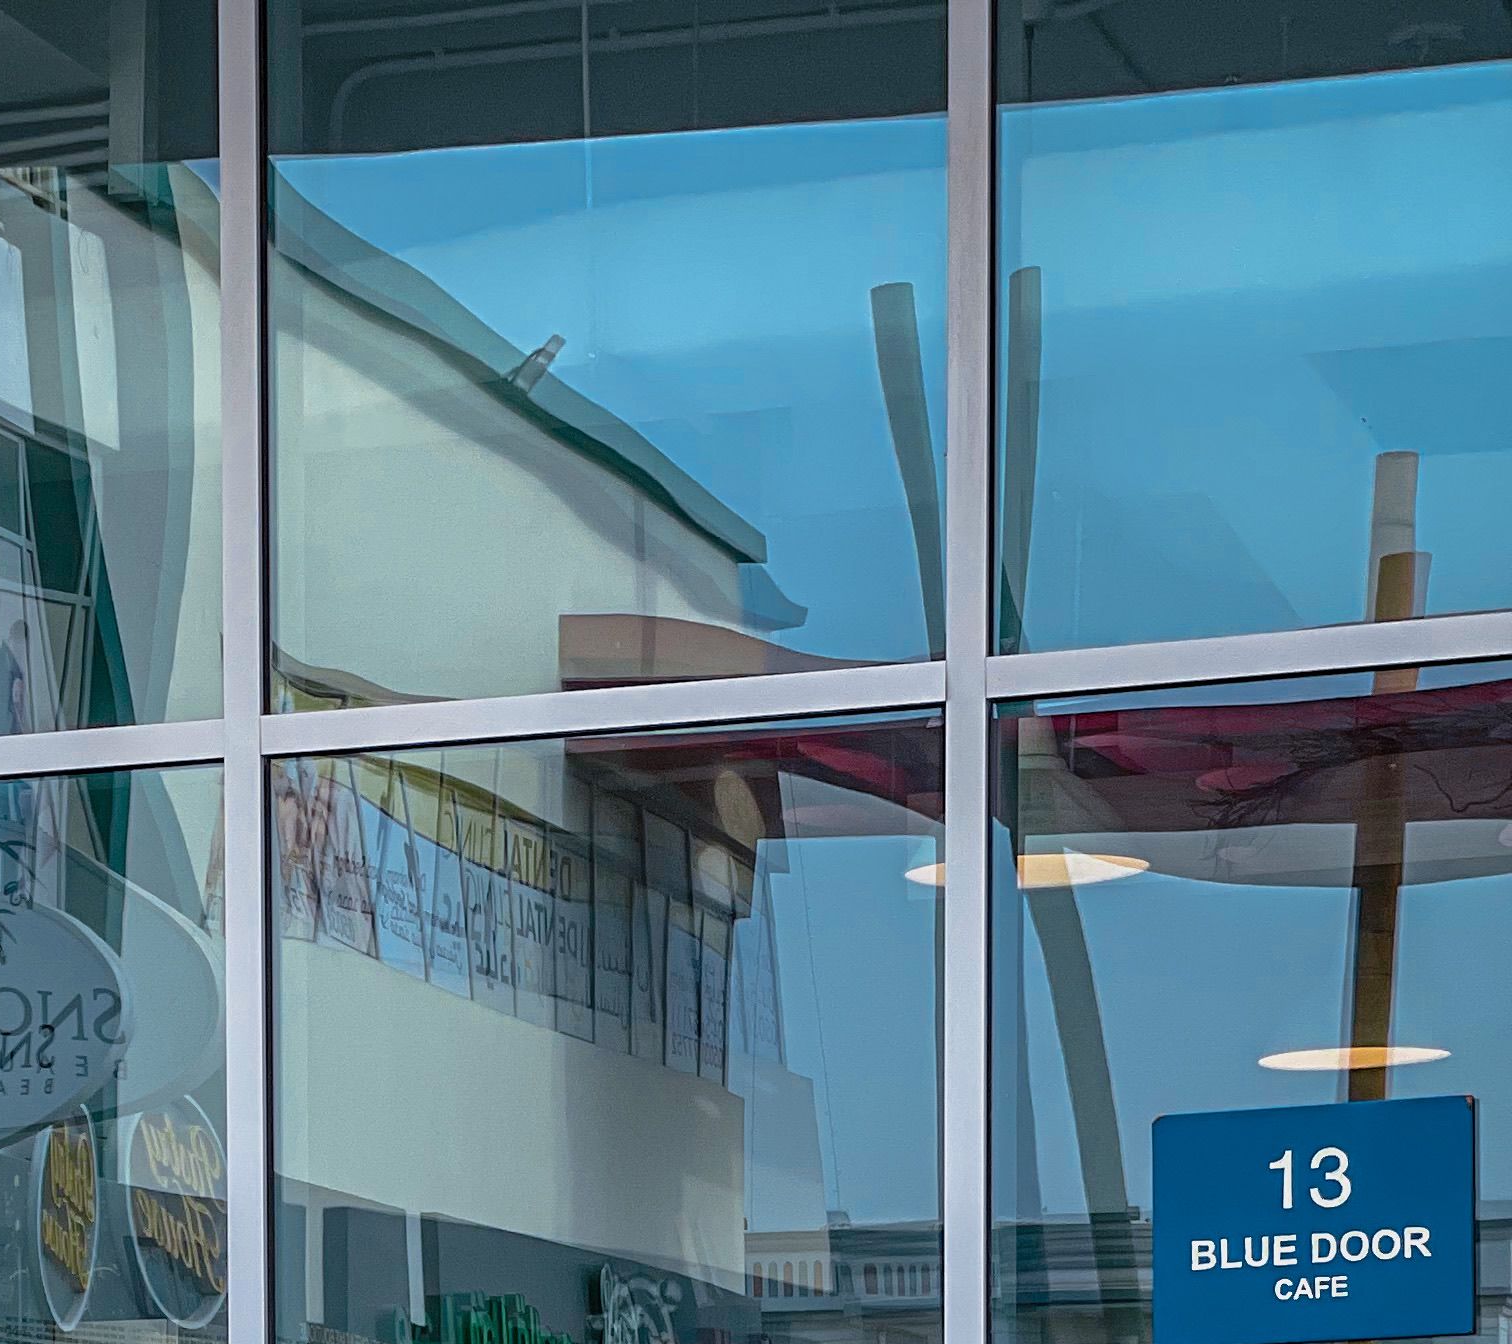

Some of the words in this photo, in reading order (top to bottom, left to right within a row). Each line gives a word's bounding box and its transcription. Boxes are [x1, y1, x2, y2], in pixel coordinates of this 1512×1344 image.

[1269, 1146, 1353, 1210] 13
[1191, 1234, 1298, 1271] BLUE
[1311, 1226, 1432, 1264] DOOR
[1274, 1275, 1349, 1300] CAFE
